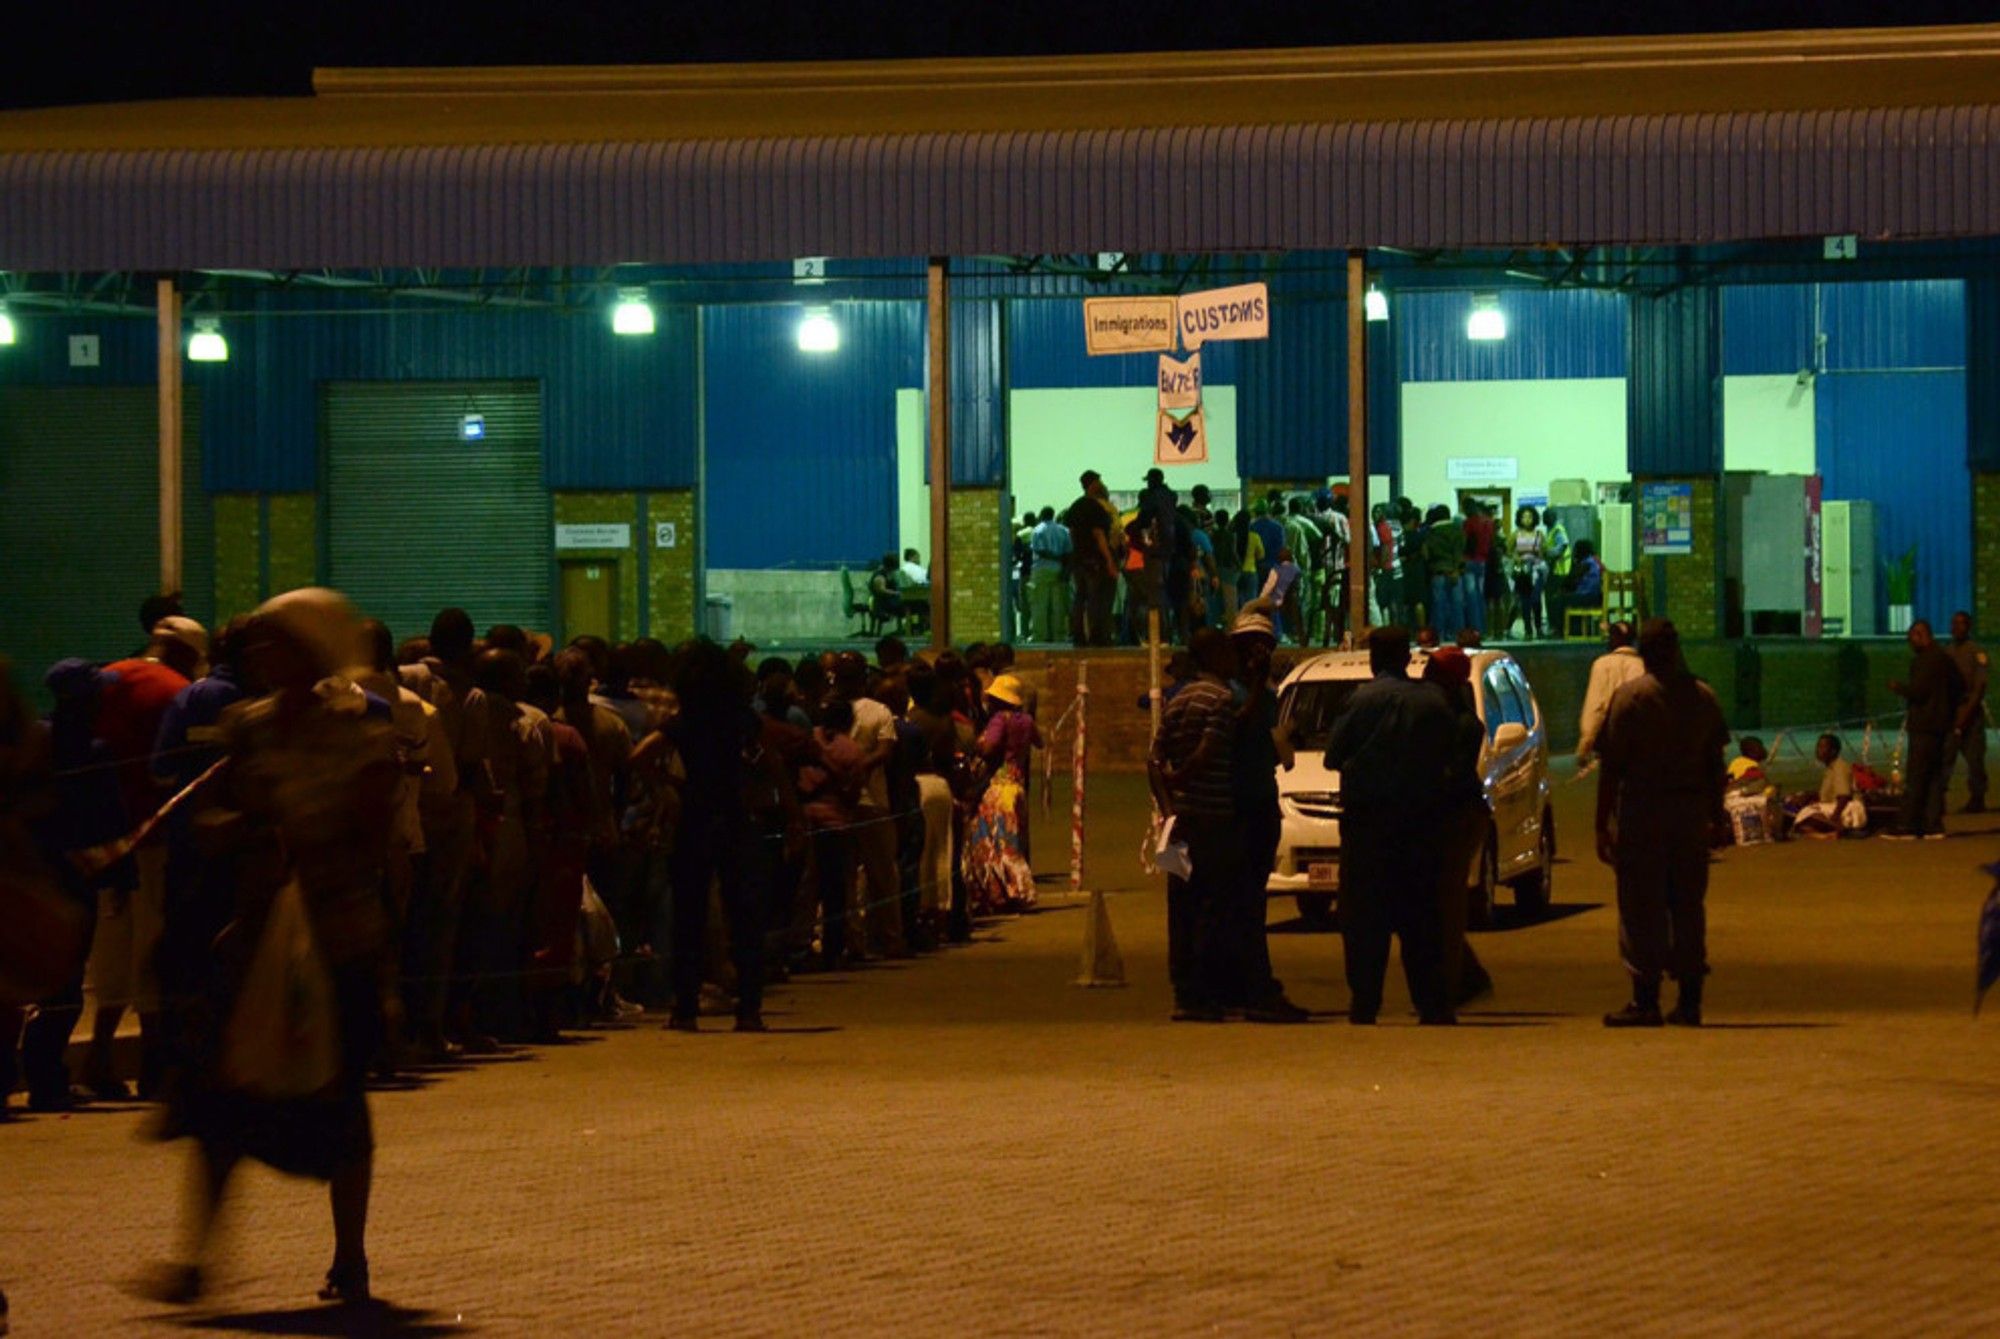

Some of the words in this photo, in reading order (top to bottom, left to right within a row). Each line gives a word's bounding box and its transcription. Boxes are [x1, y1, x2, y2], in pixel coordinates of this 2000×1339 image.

[804, 262, 814, 276] 2
[1094, 314, 1167, 336] Immigrations
[1183, 295, 1264, 335] CUSTOMS
